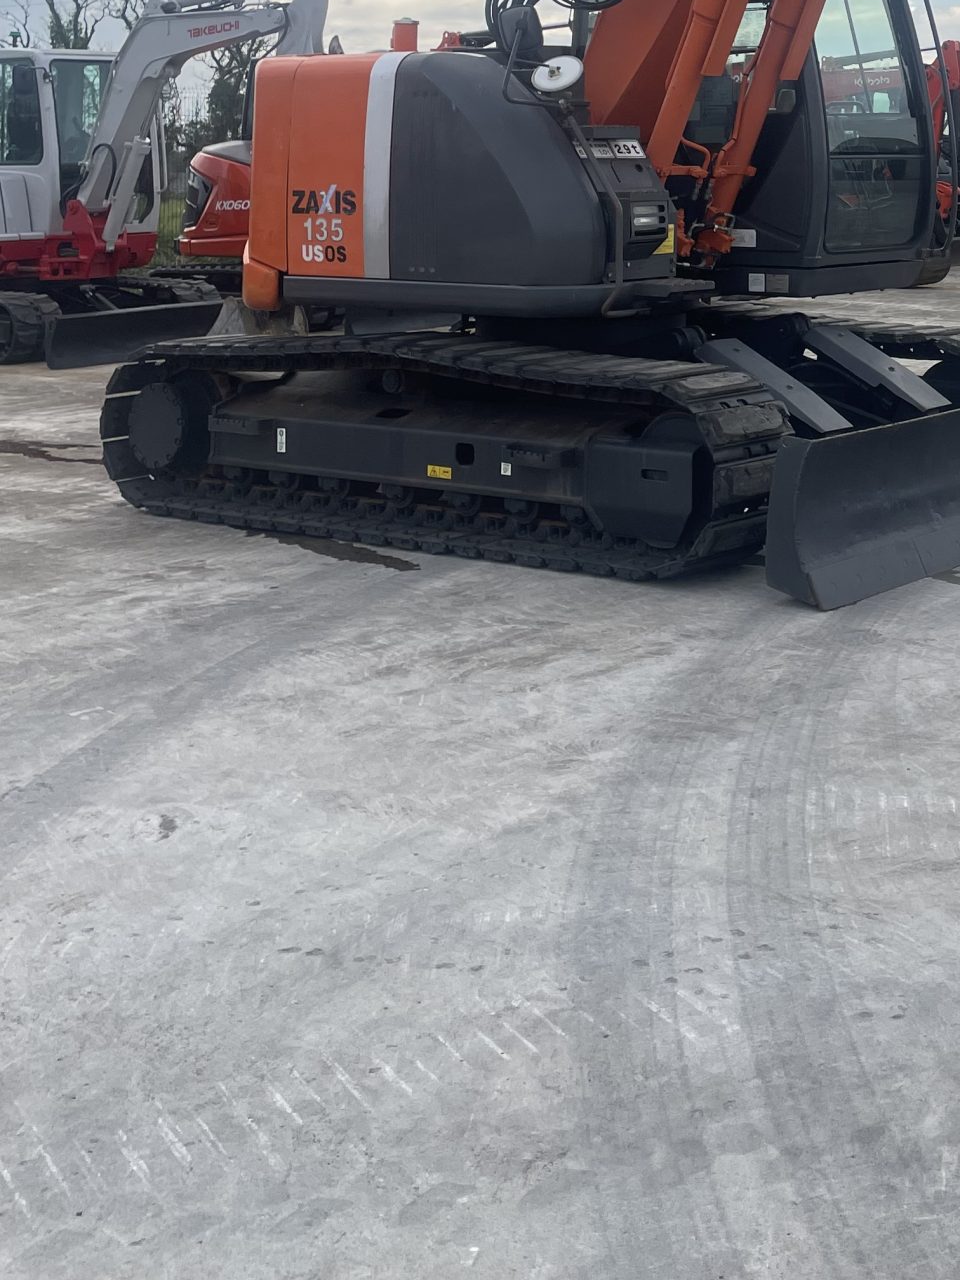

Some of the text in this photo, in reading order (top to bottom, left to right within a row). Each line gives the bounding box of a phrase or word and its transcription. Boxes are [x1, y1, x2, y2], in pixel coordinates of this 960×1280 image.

[854, 76, 890, 87] Kbota
[215, 200, 250, 211] KX060
[292, 184, 357, 215] ZAXIS
[303, 218, 344, 241] 135
[302, 244, 347, 262] USOS
